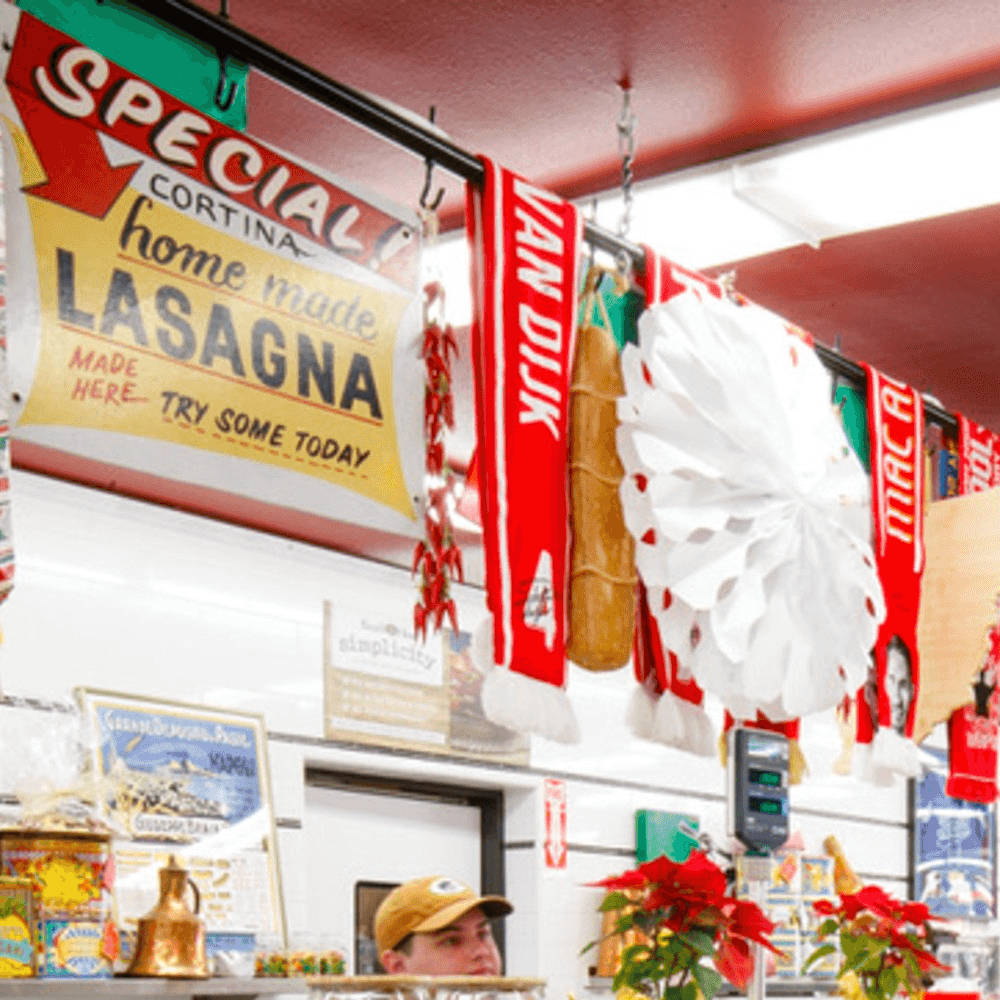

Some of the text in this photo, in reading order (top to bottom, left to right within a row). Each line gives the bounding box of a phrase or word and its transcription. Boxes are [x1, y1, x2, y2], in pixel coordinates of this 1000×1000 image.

[149, 172, 318, 259] CORTINA
[118, 192, 380, 342] home made
[512, 178, 564, 442] VAN DIJK
[55, 246, 384, 420] LASAGNA
[68, 346, 139, 379] MADE
[71, 377, 149, 405] HERE
[160, 390, 371, 469] TRY SOME TODAY
